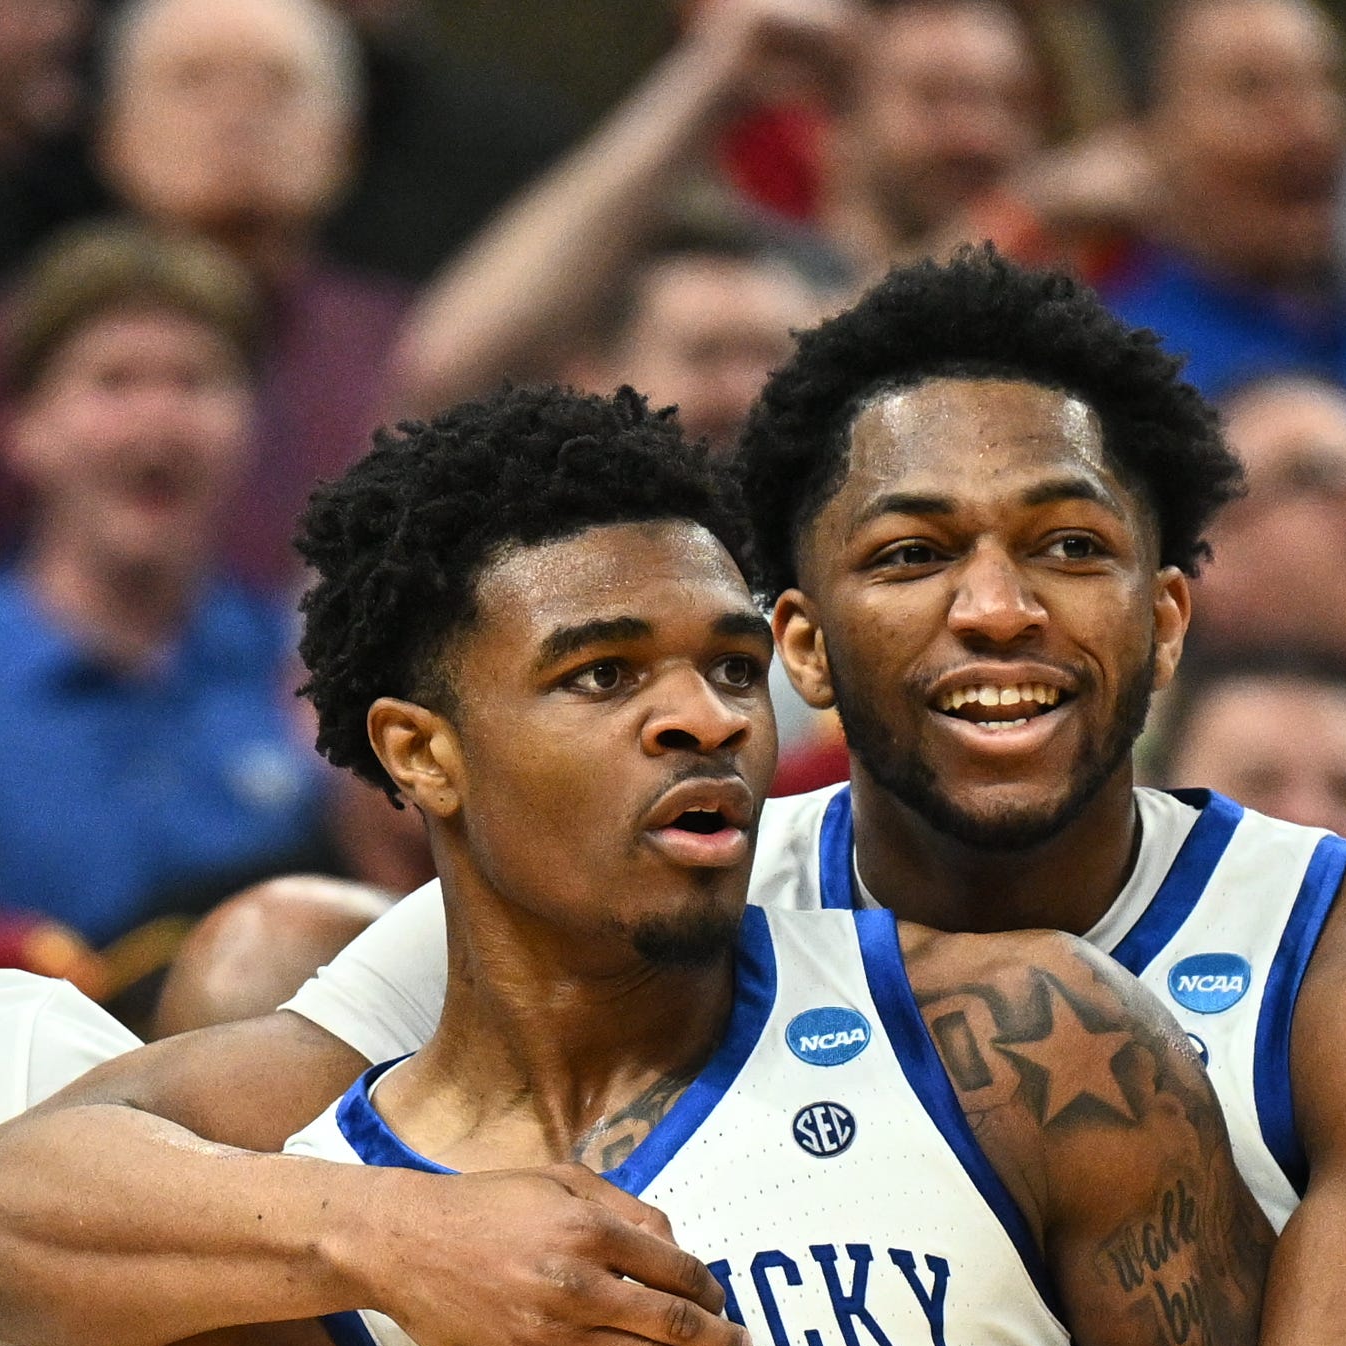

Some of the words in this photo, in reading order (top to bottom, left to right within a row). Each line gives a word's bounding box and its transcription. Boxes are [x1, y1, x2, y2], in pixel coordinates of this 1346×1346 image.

[1177, 974, 1245, 993] NCAA
[799, 1028, 866, 1052] NCAA
[796, 1104, 852, 1153] SEC
